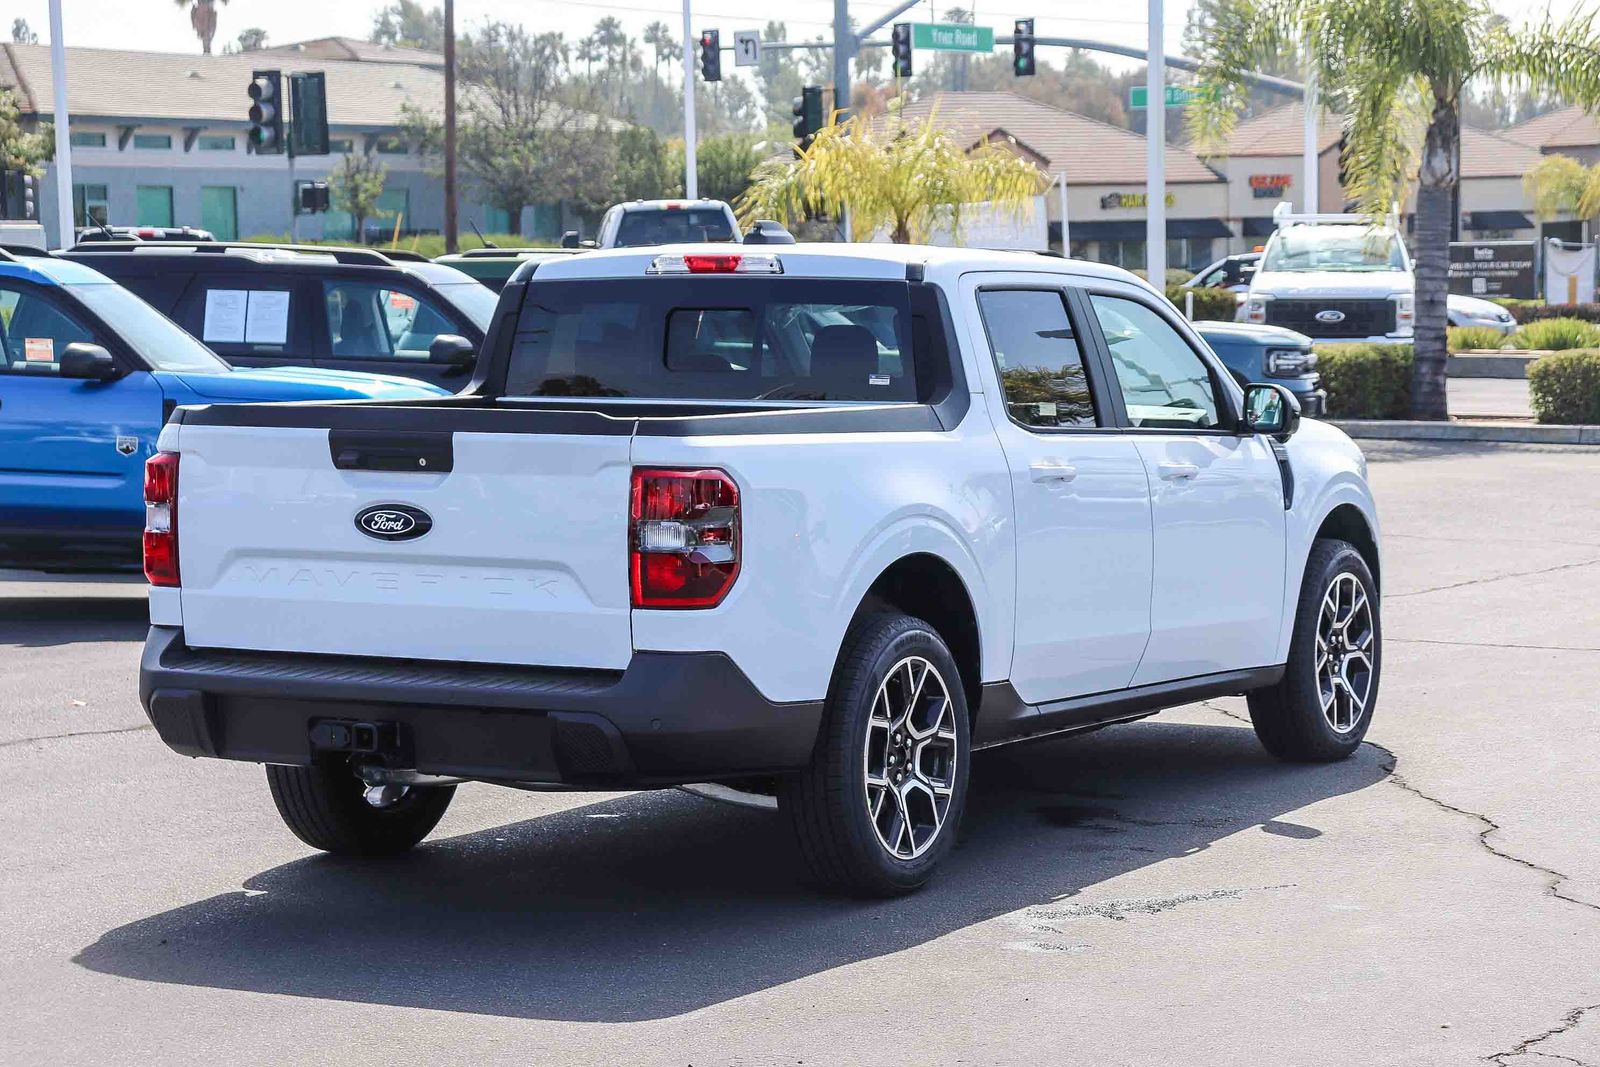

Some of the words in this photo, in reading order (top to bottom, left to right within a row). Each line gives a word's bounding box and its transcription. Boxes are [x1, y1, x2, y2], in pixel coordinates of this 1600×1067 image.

[955, 29, 977, 47] Road
[371, 513, 404, 530] Ford
[243, 566, 560, 599] MAVERICK
